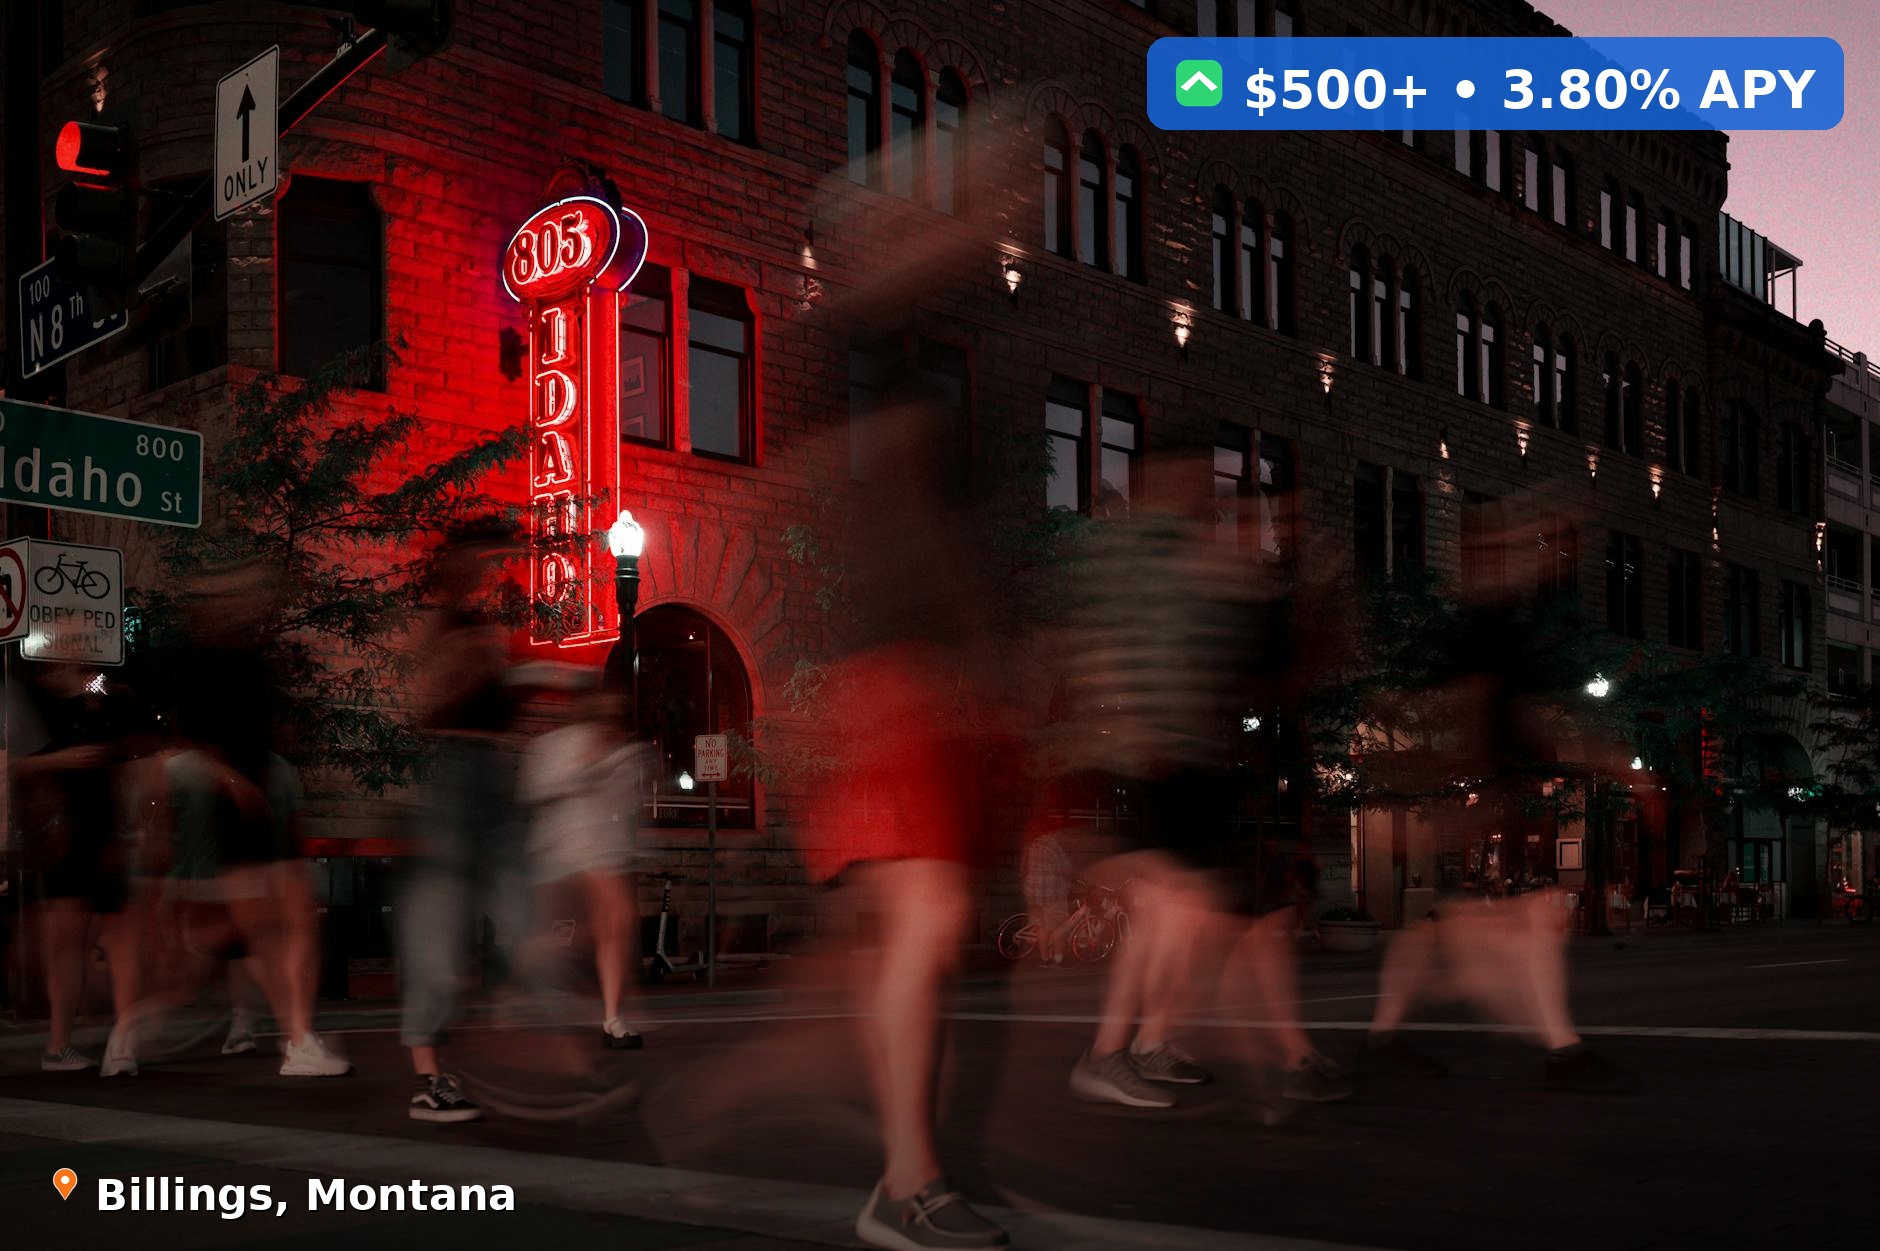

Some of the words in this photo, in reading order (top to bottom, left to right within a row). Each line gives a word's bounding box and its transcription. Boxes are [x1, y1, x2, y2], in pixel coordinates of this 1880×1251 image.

[225, 155, 268, 202] ONLY
[511, 210, 591, 286] 805
[29, 274, 50, 305] 100
[30, 311, 43, 362] N
[136, 433, 184, 462] 800
[534, 306, 576, 608] IDAHO
[160, 490, 183, 514] St
[30, 605, 75, 625] OBEY
[83, 610, 115, 629] PED
[43, 632, 103, 653] SIGNAL
[697, 749, 725, 758] PARKING
[705, 739, 716, 748] NO
[659, 807, 680, 820] FORK
